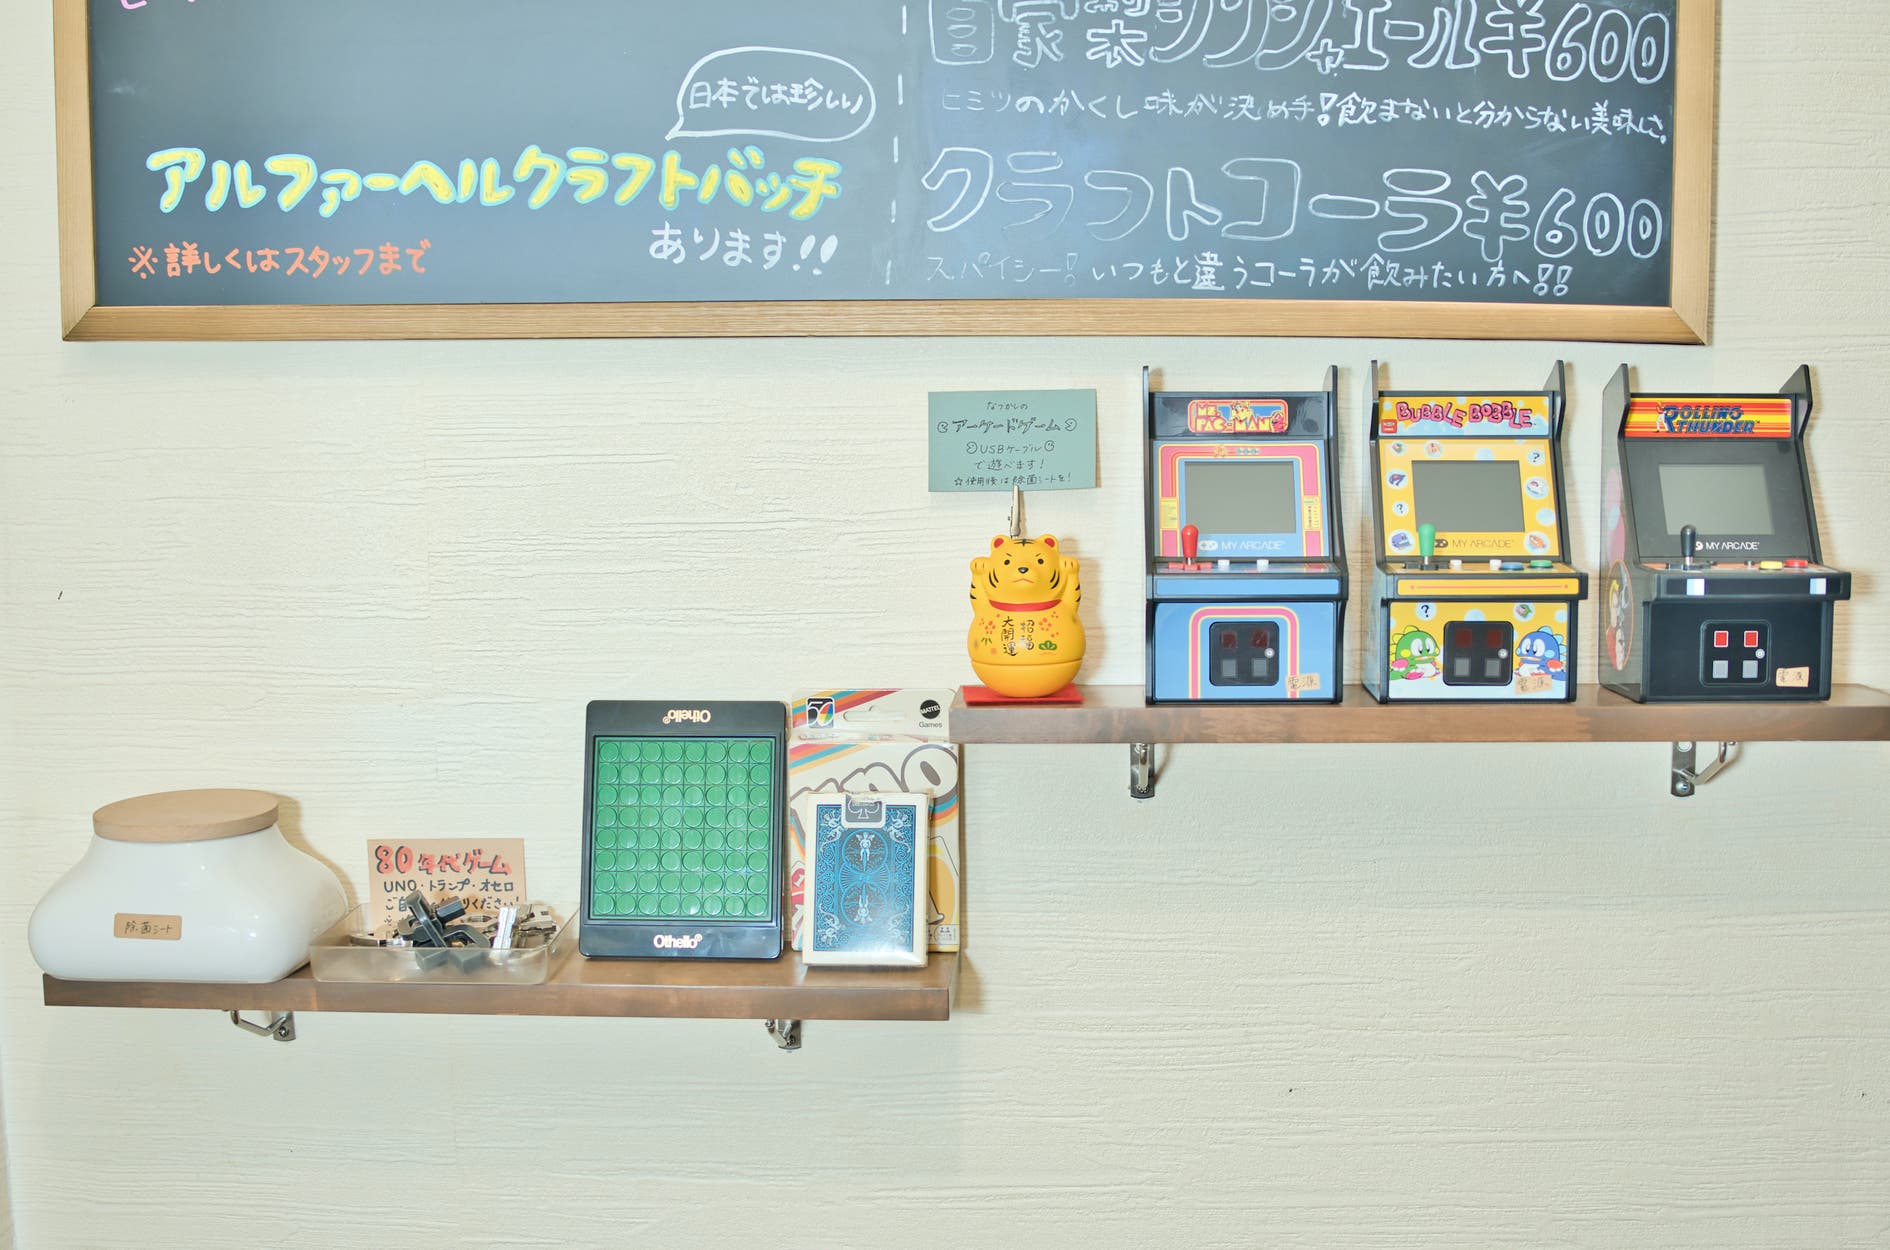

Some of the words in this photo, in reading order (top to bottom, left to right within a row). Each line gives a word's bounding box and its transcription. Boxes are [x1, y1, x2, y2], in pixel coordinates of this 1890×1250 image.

[689, 76, 864, 115] 日本では珍しい
[146, 144, 842, 220] アルファーヘルクラフトバッチ
[649, 221, 838, 275] あります!!
[1396, 401, 1466, 428] BUBBLE
[1468, 400, 1532, 429] BOBBLE
[952, 416, 1061, 434] アーケードゲーム
[1196, 416, 1271, 432] PAC-MAN
[1676, 419, 1755, 433] THUNDER
[1221, 541, 1237, 550] MY
[1239, 540, 1285, 550] ARCADE
[1452, 540, 1467, 548] MY
[1470, 540, 1512, 548] ARCADE
[1705, 541, 1720, 550] MY
[1721, 541, 1760, 550] ARCADE
[667, 709, 711, 723] Othello
[920, 704, 941, 713] MATTEL
[375, 845, 513, 876] 80年代ゲーム
[653, 934, 698, 949] Othello
